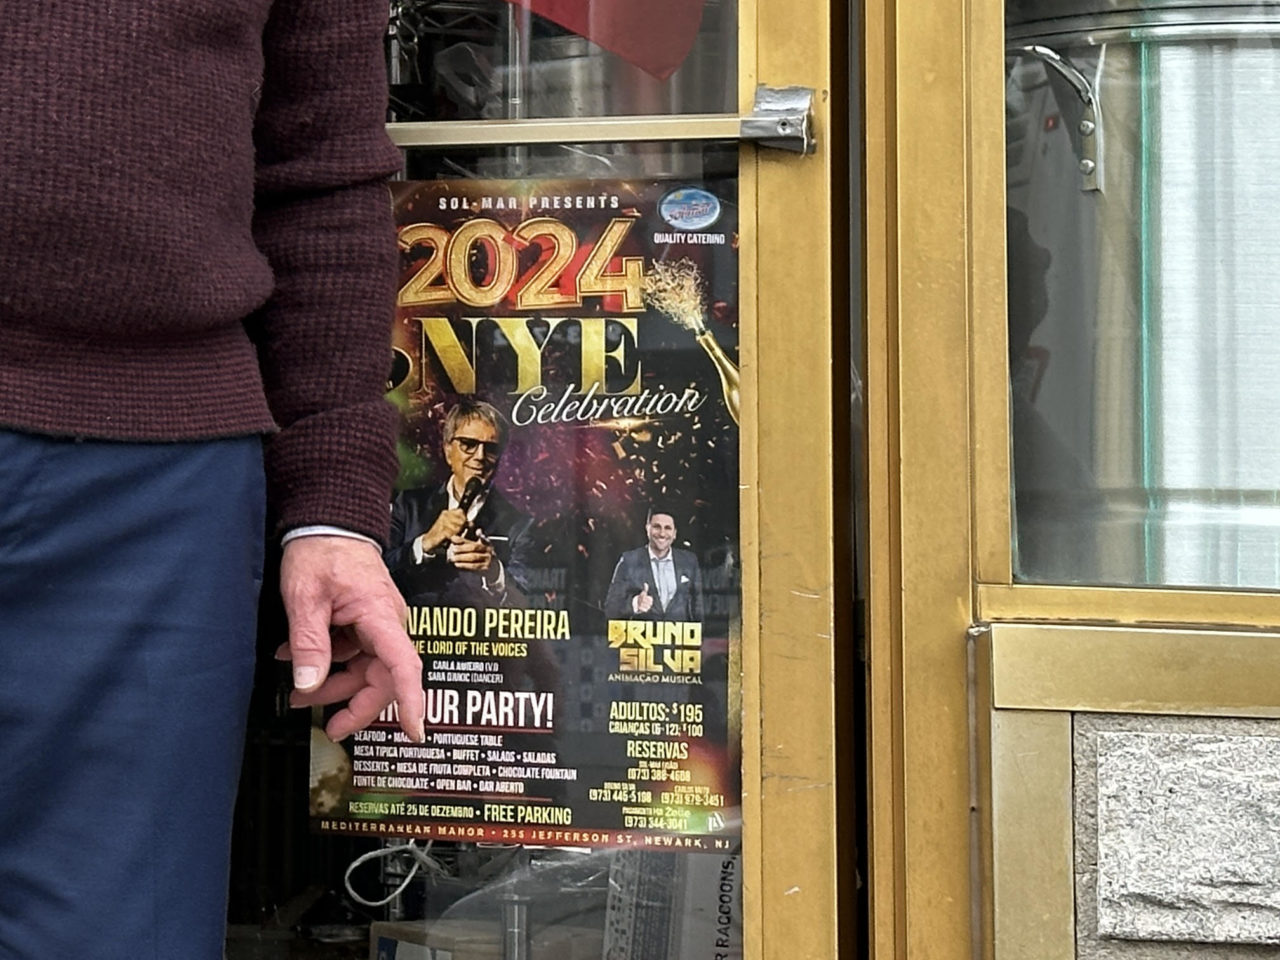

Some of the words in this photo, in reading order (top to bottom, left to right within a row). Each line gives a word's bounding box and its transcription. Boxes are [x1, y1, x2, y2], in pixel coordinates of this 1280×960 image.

[438, 196, 519, 210] SOL-MAR
[528, 194, 620, 211] PRESENTS
[654, 232, 686, 244] QUALITY
[398, 217, 647, 314] 2024
[412, 316, 642, 397] NYE
[511, 381, 708, 427] Celebration
[406, 606, 477, 638] NANDO
[483, 608, 571, 640] PEREIRA
[608, 620, 702, 648] BRUNO
[427, 640, 453, 655] LORD
[455, 641, 468, 655] OF
[470, 642, 489, 656] THE
[491, 643, 528, 658] VOICES
[619, 646, 702, 674] SILVA
[661, 675, 703, 685] MUSICAL
[466, 690, 554, 728] PARTY!
[609, 700, 670, 722] ADULTOS:
[672, 702, 703, 723] $195
[480, 735, 503, 747] TABLE
[626, 739, 689, 759] RESERVAS
[418, 762, 428, 774] DE
[452, 749, 480, 761] BUFFET
[486, 750, 516, 762] SALADS
[522, 751, 557, 764] SALADAS
[353, 775, 376, 787] FONTE
[376, 776, 387, 788] DE
[390, 800, 405, 816] ATÉ
[418, 804, 430, 816] DE
[483, 803, 516, 822] FREE
[517, 805, 573, 825] PARKING
[321, 820, 431, 834] MEDITERRANEAN
[438, 825, 485, 838] MANOR
[531, 829, 609, 843] JEFFERSON
[715, 840, 730, 849] NJ
[715, 854, 738, 949] RACCOONS,
